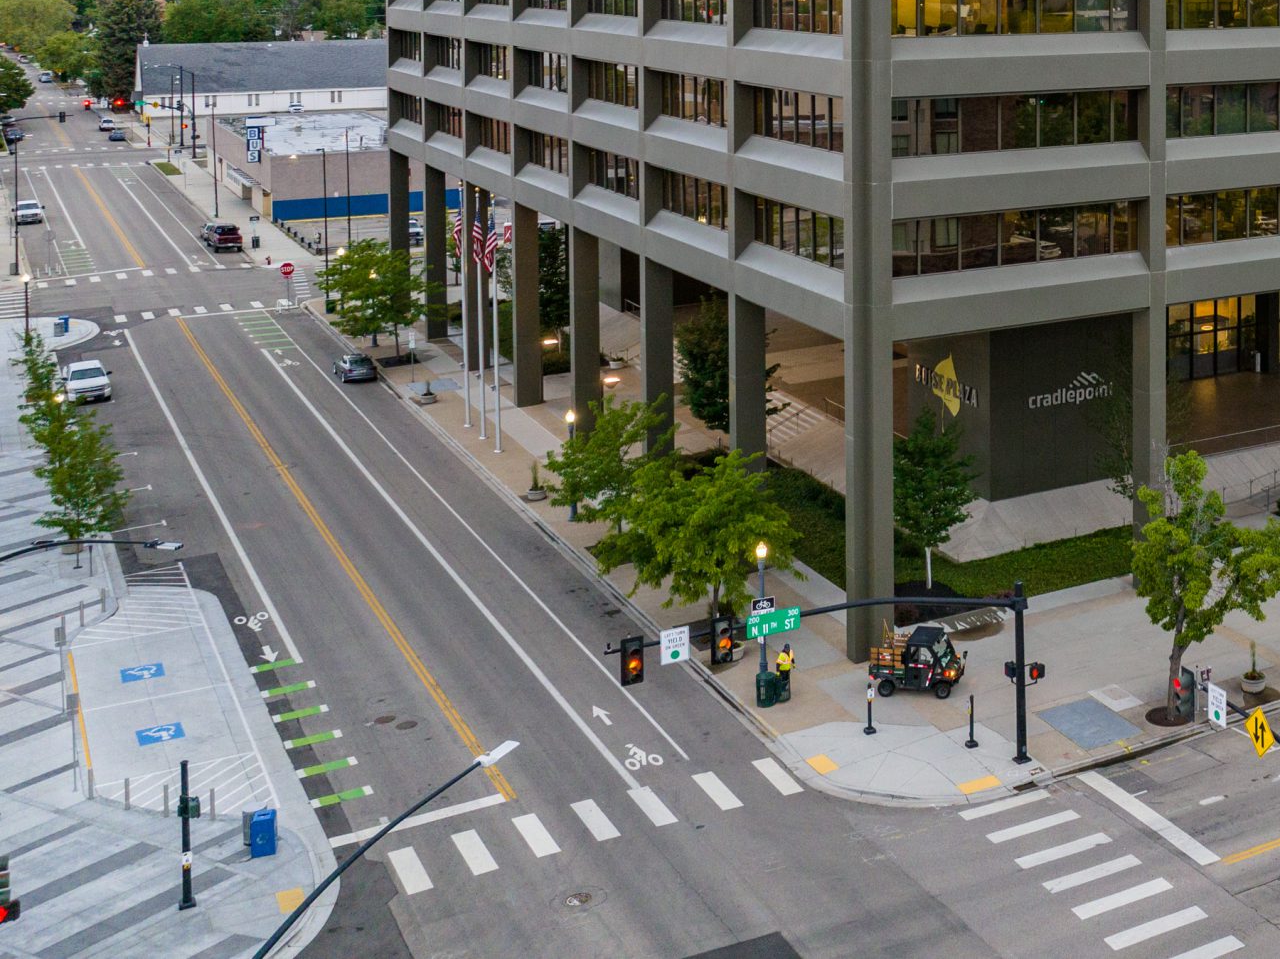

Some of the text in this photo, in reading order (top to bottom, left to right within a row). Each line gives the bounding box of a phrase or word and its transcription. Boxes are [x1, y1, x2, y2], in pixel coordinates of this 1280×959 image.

[249, 129, 258, 161] BUS
[946, 377, 978, 408] PLAZA
[787, 608, 799, 617] 300
[748, 616, 760, 625] 200
[784, 618, 795, 630] ST
